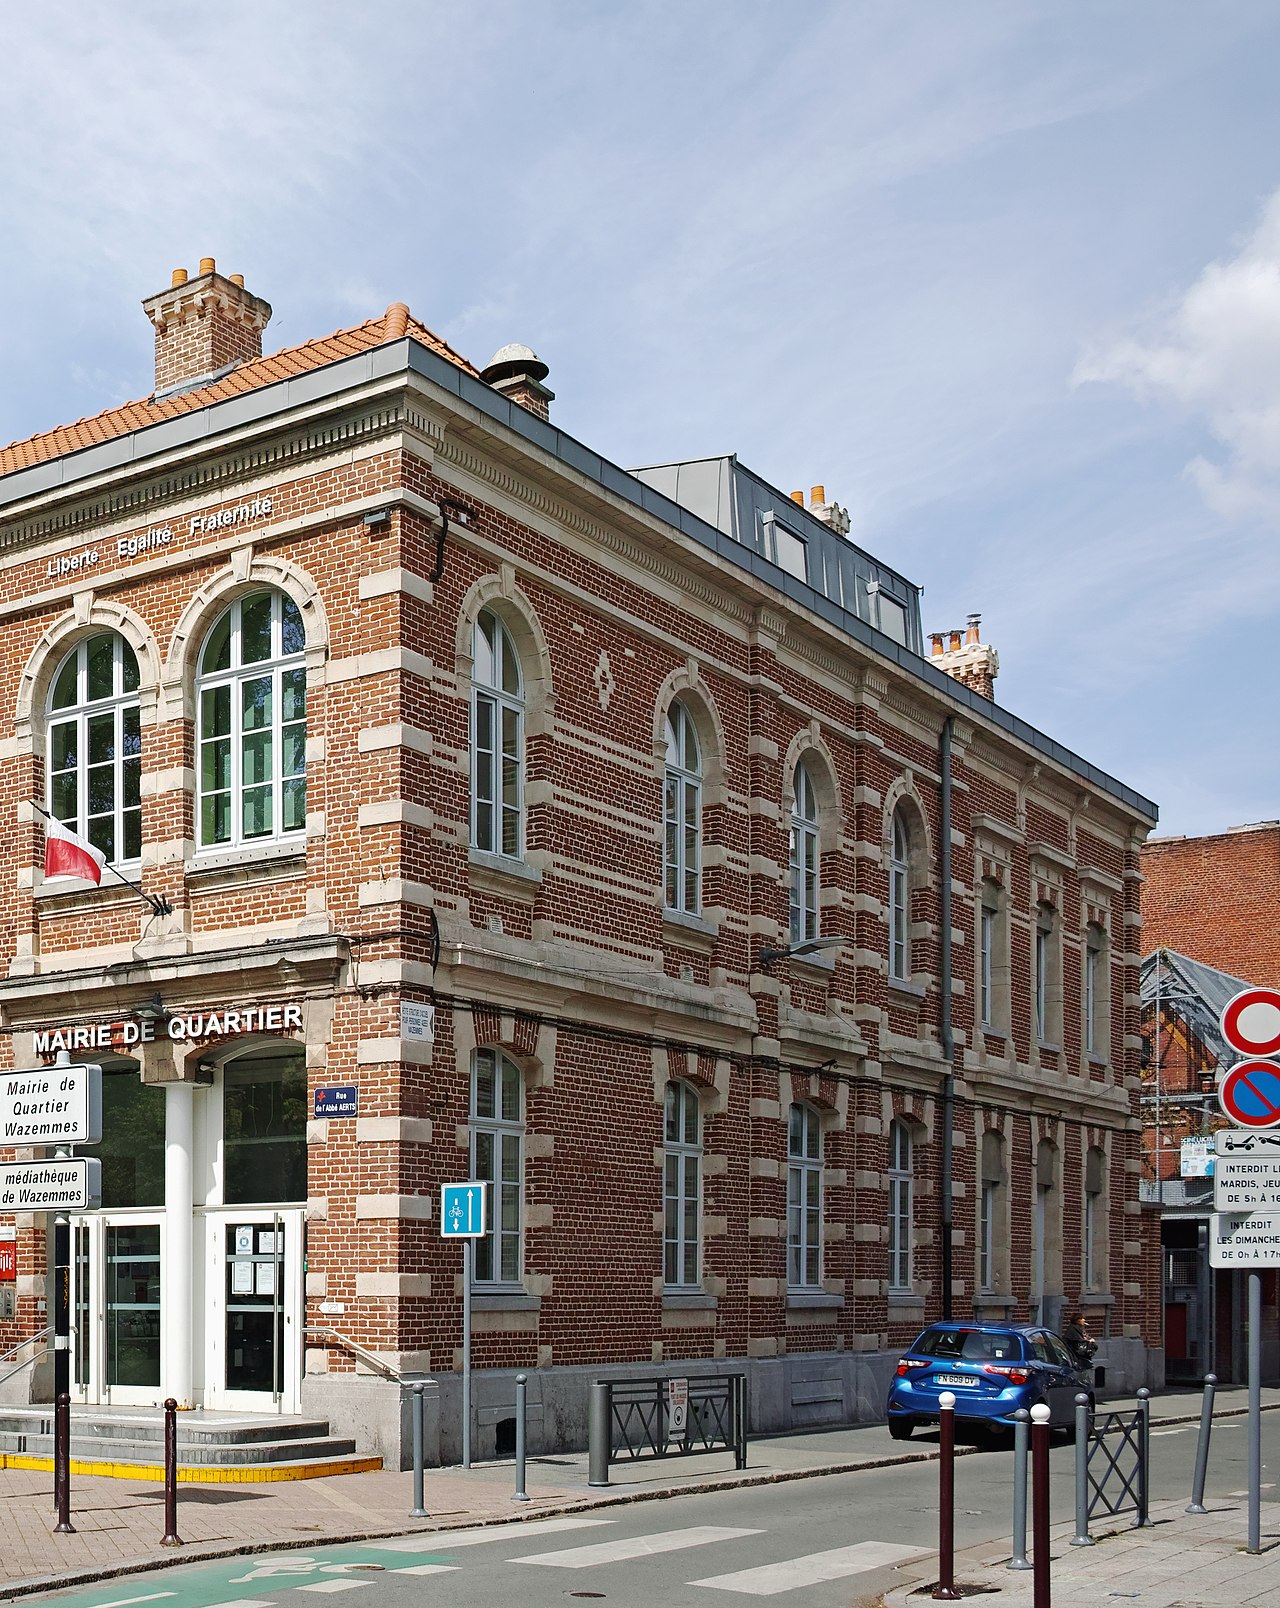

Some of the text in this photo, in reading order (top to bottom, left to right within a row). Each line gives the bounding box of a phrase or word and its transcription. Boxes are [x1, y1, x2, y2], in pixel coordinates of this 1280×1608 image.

[47, 546, 99, 577] Liberté
[189, 494, 272, 536] Fraternité
[32, 1005, 302, 1053] MAIRIE DE QUARTIER
[7, 1077, 75, 1096] Mairie de
[335, 1091, 347, 1100] Rue
[13, 1099, 69, 1116] Quartier
[338, 1102, 356, 1111] AERTS
[5, 1121, 78, 1137] Wazemmes
[1225, 1165, 1269, 1173] INTERDIT
[5, 1168, 78, 1187] médiathèque
[1220, 1180, 1259, 1189] MARDIS,
[2, 1188, 82, 1204] de Wazemmes
[1227, 1194, 1240, 1203] DE
[1230, 1220, 1272, 1230] INTERDIT
[1217, 1235, 1280, 1245] LES DIMANCHE
[1221, 1251, 1234, 1259] DE
